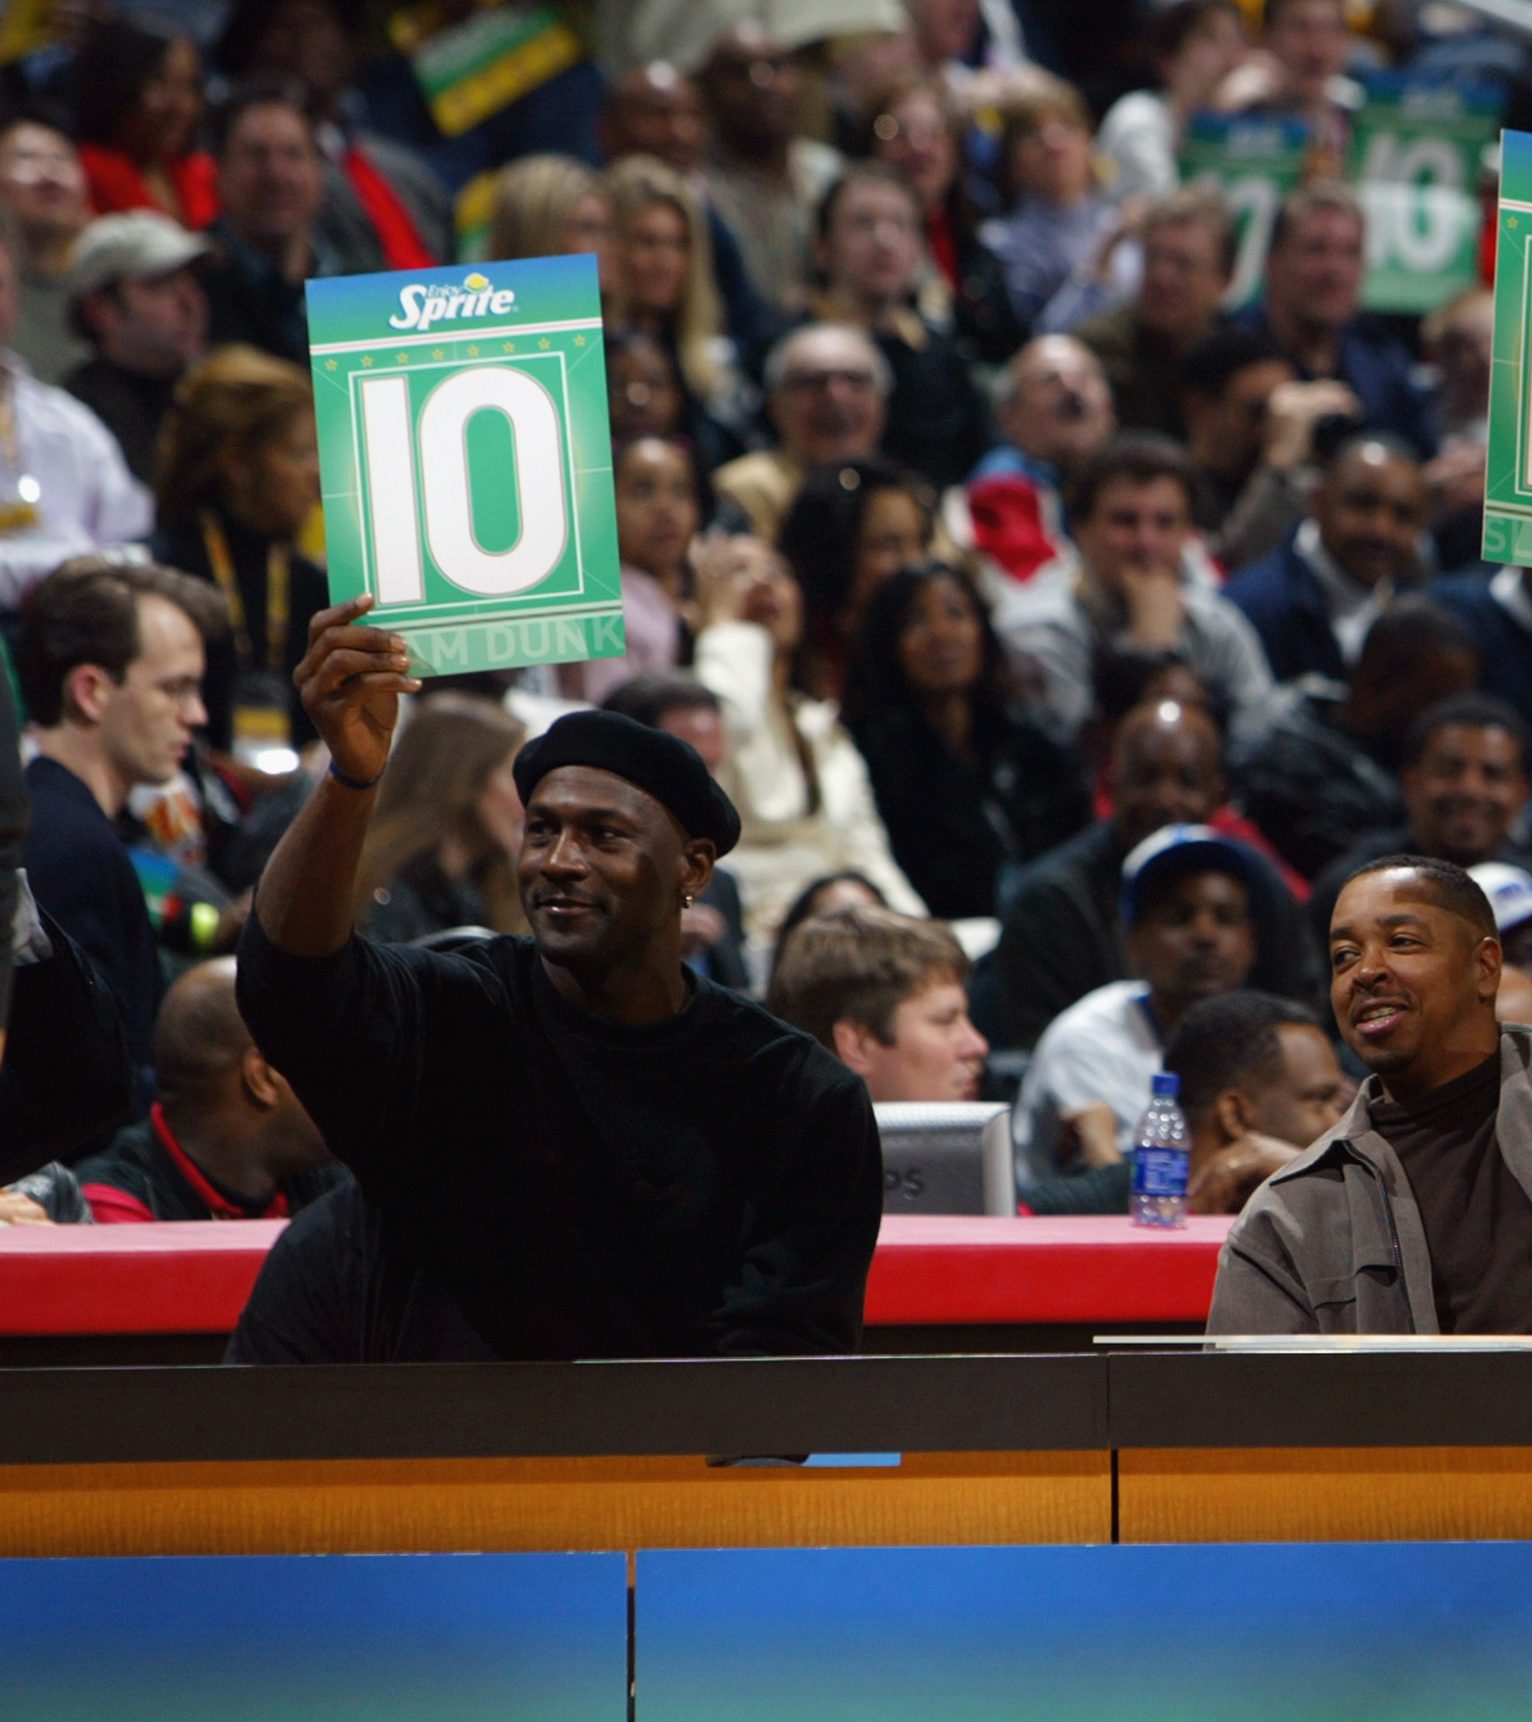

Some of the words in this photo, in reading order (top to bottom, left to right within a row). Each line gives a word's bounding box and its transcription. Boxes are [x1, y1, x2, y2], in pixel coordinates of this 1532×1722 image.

[388, 273, 515, 331] Sprite
[360, 365, 568, 606] 10
[486, 614, 626, 664] DUNK
